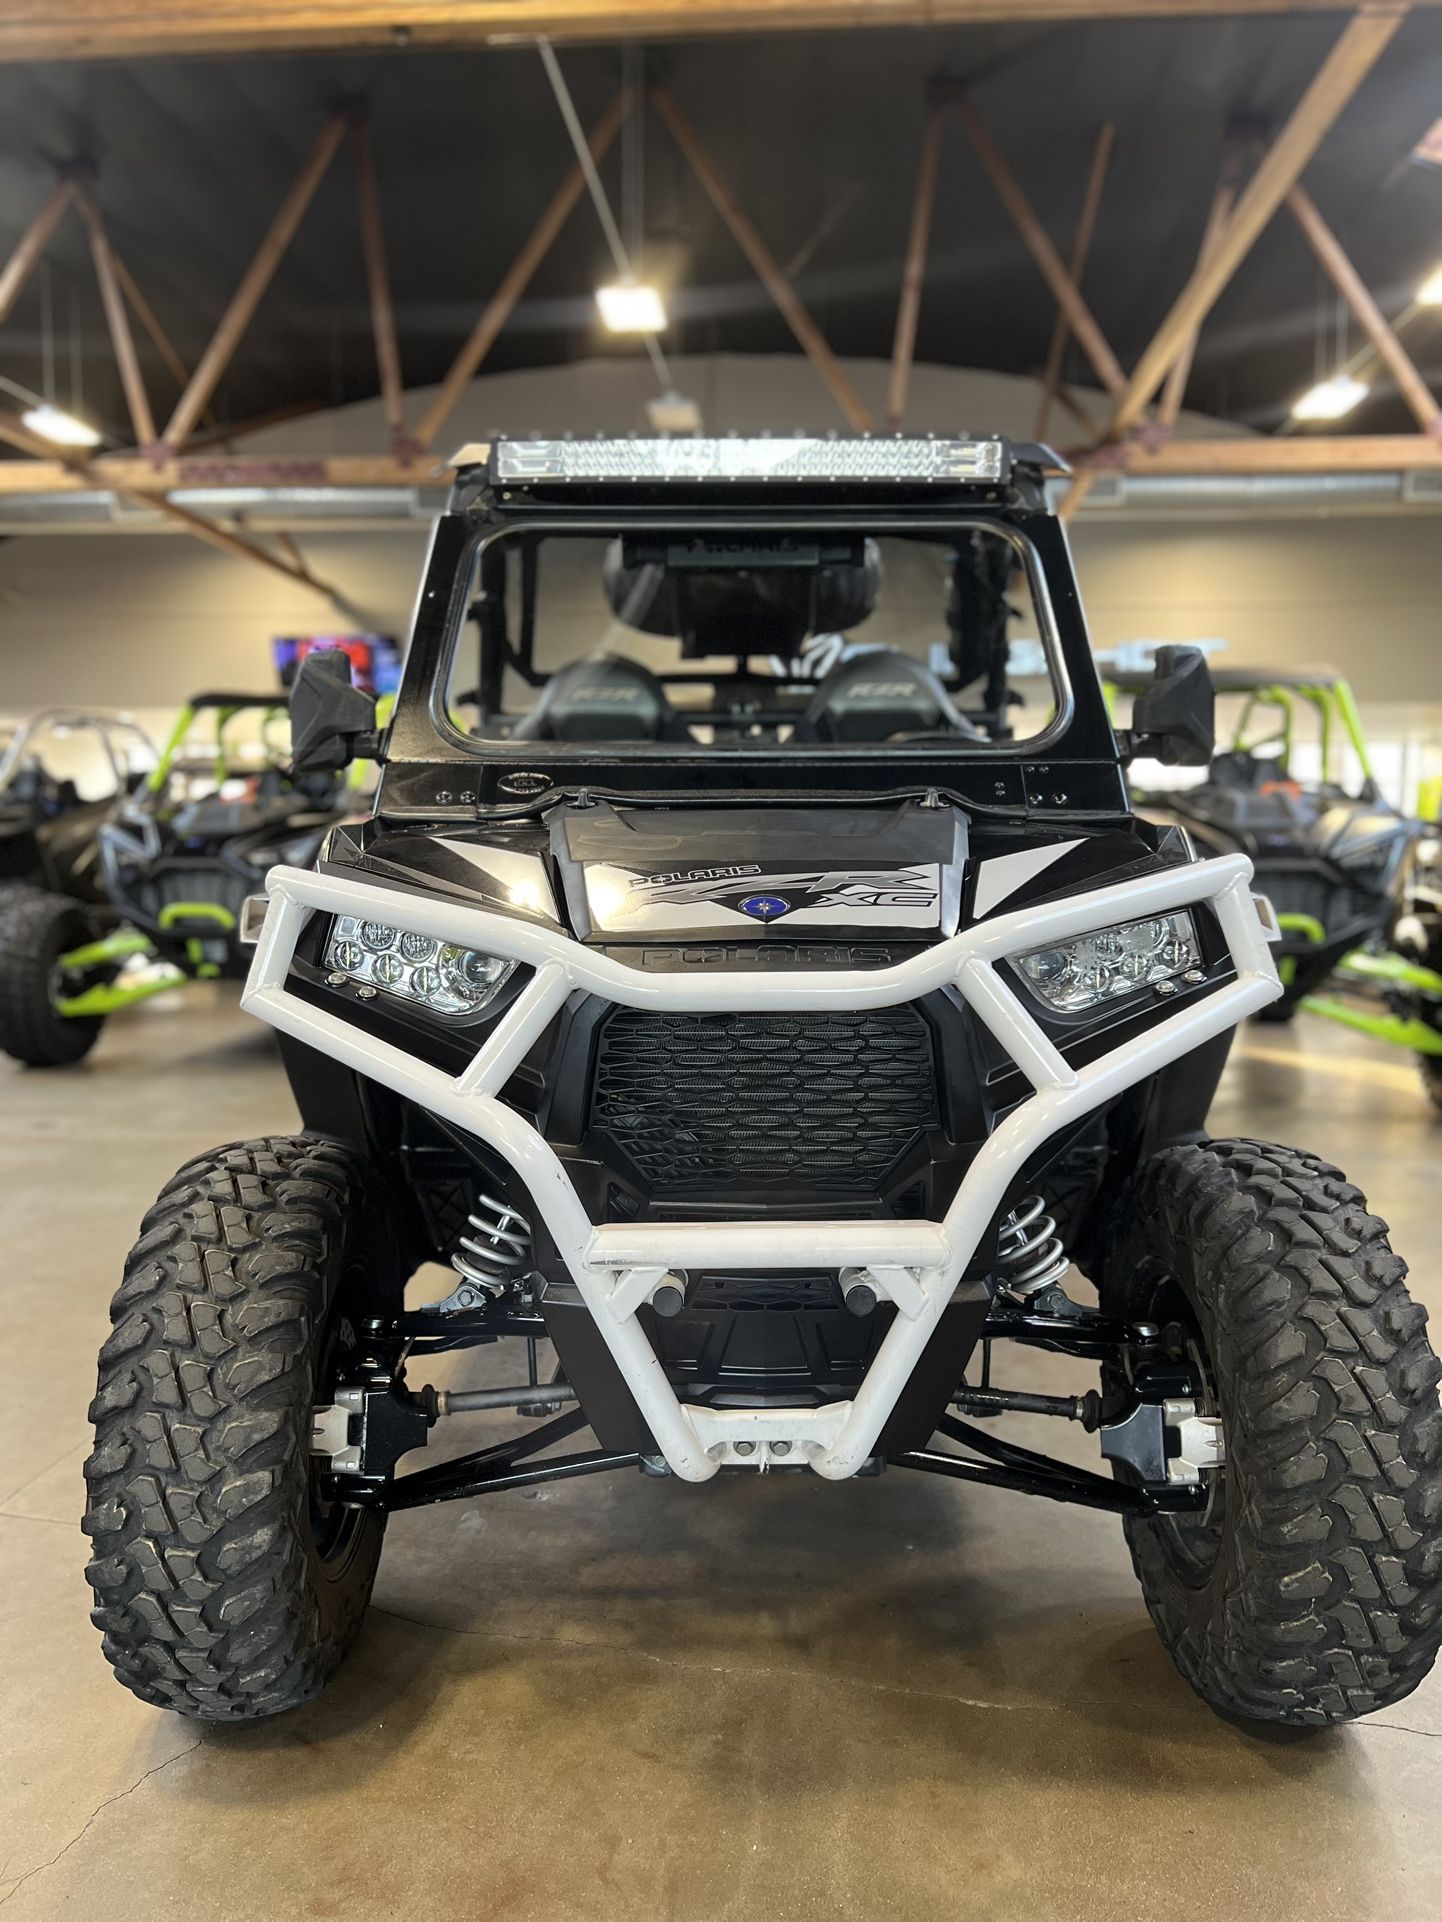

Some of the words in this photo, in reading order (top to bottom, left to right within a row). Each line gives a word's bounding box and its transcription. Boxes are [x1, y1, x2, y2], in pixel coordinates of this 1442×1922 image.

[629, 865, 761, 887] POLARIS
[807, 891, 939, 908] XC
[641, 945, 892, 966] POLARIS
